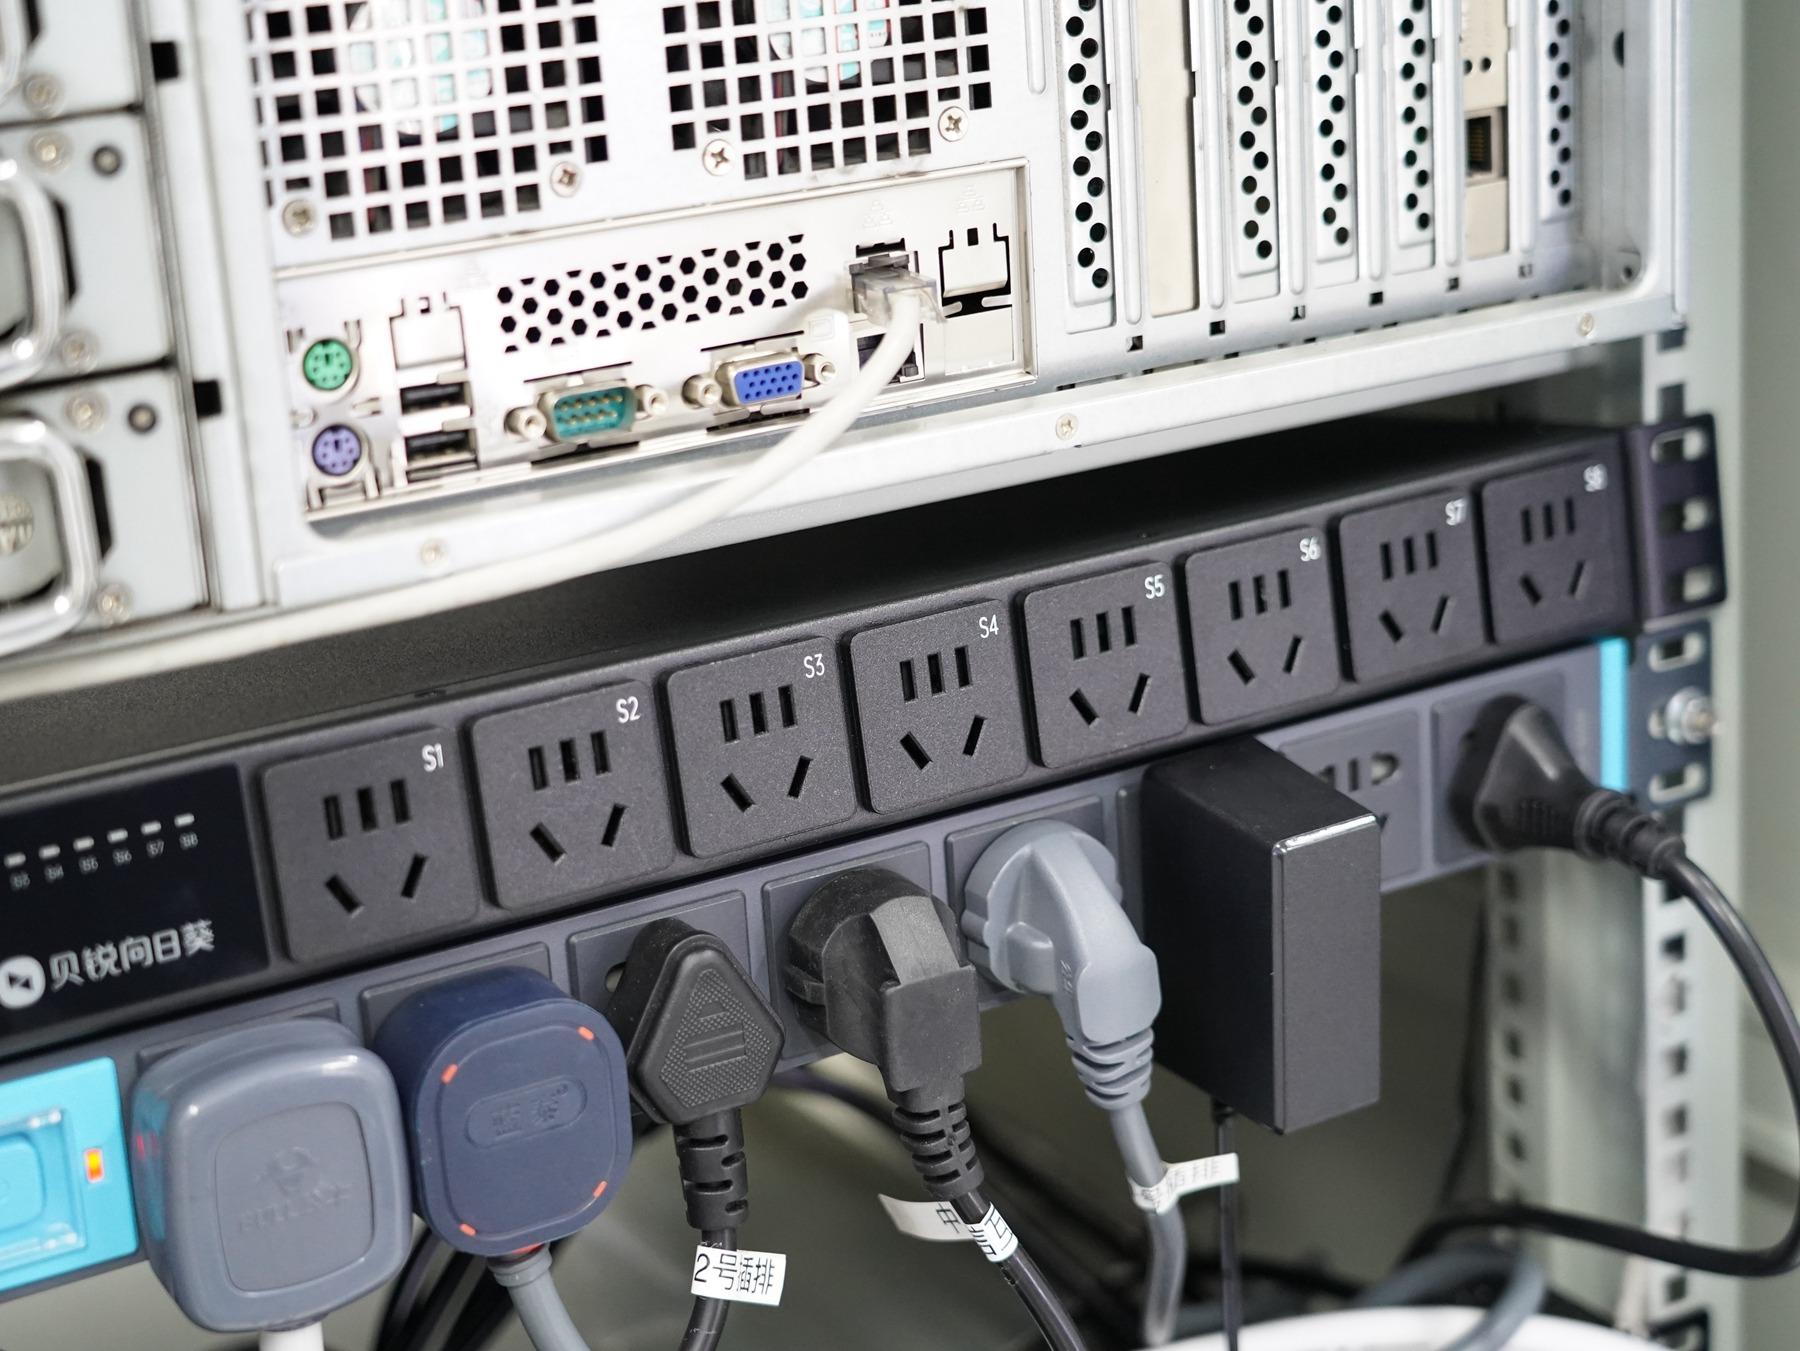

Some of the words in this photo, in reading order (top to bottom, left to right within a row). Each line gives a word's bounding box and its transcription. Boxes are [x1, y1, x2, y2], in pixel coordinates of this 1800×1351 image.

[1445, 499, 1466, 525] S7
[1300, 538, 1321, 562] S6
[1145, 574, 1165, 599] S5
[979, 614, 999, 639] S4
[804, 653, 825, 679] S3
[616, 696, 641, 723] S2
[422, 743, 443, 772] S1
[50, 918, 215, 991] 贝锐向日葵
[694, 1253, 775, 1295] 2号插排
